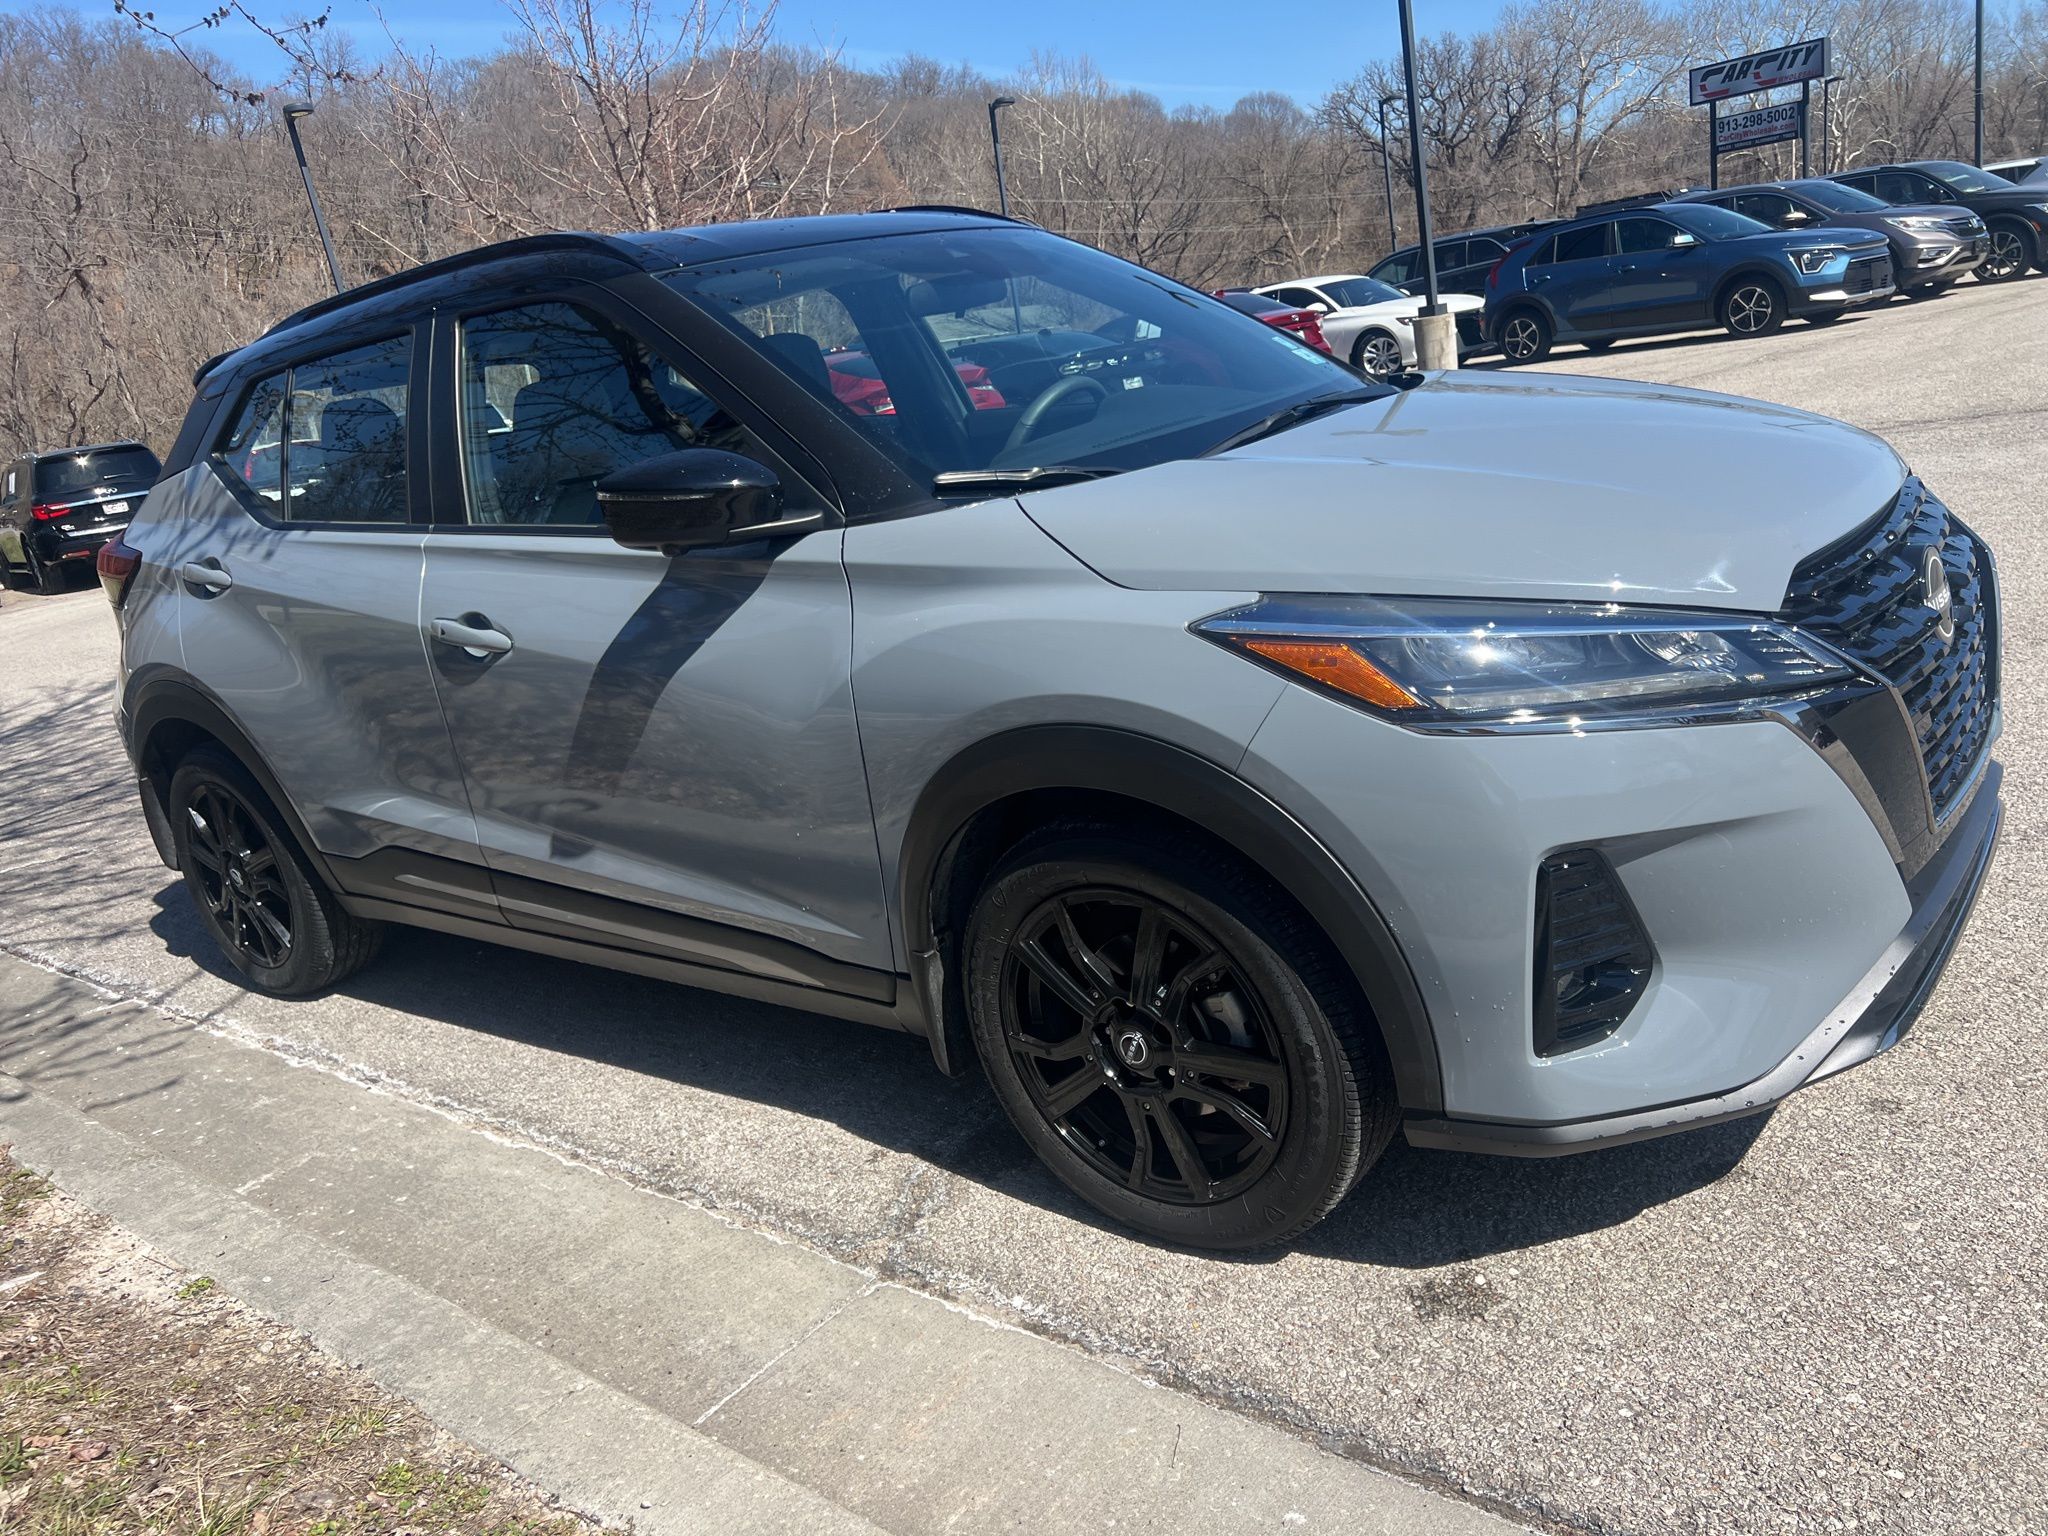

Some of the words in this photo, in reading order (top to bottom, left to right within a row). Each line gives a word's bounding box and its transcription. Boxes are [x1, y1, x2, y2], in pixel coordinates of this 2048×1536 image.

[1718, 106, 1795, 133] 913-298-5002
[1718, 122, 1796, 143] CarCityWholesale.com
[1125, 1031, 1143, 1066] NISSAN
